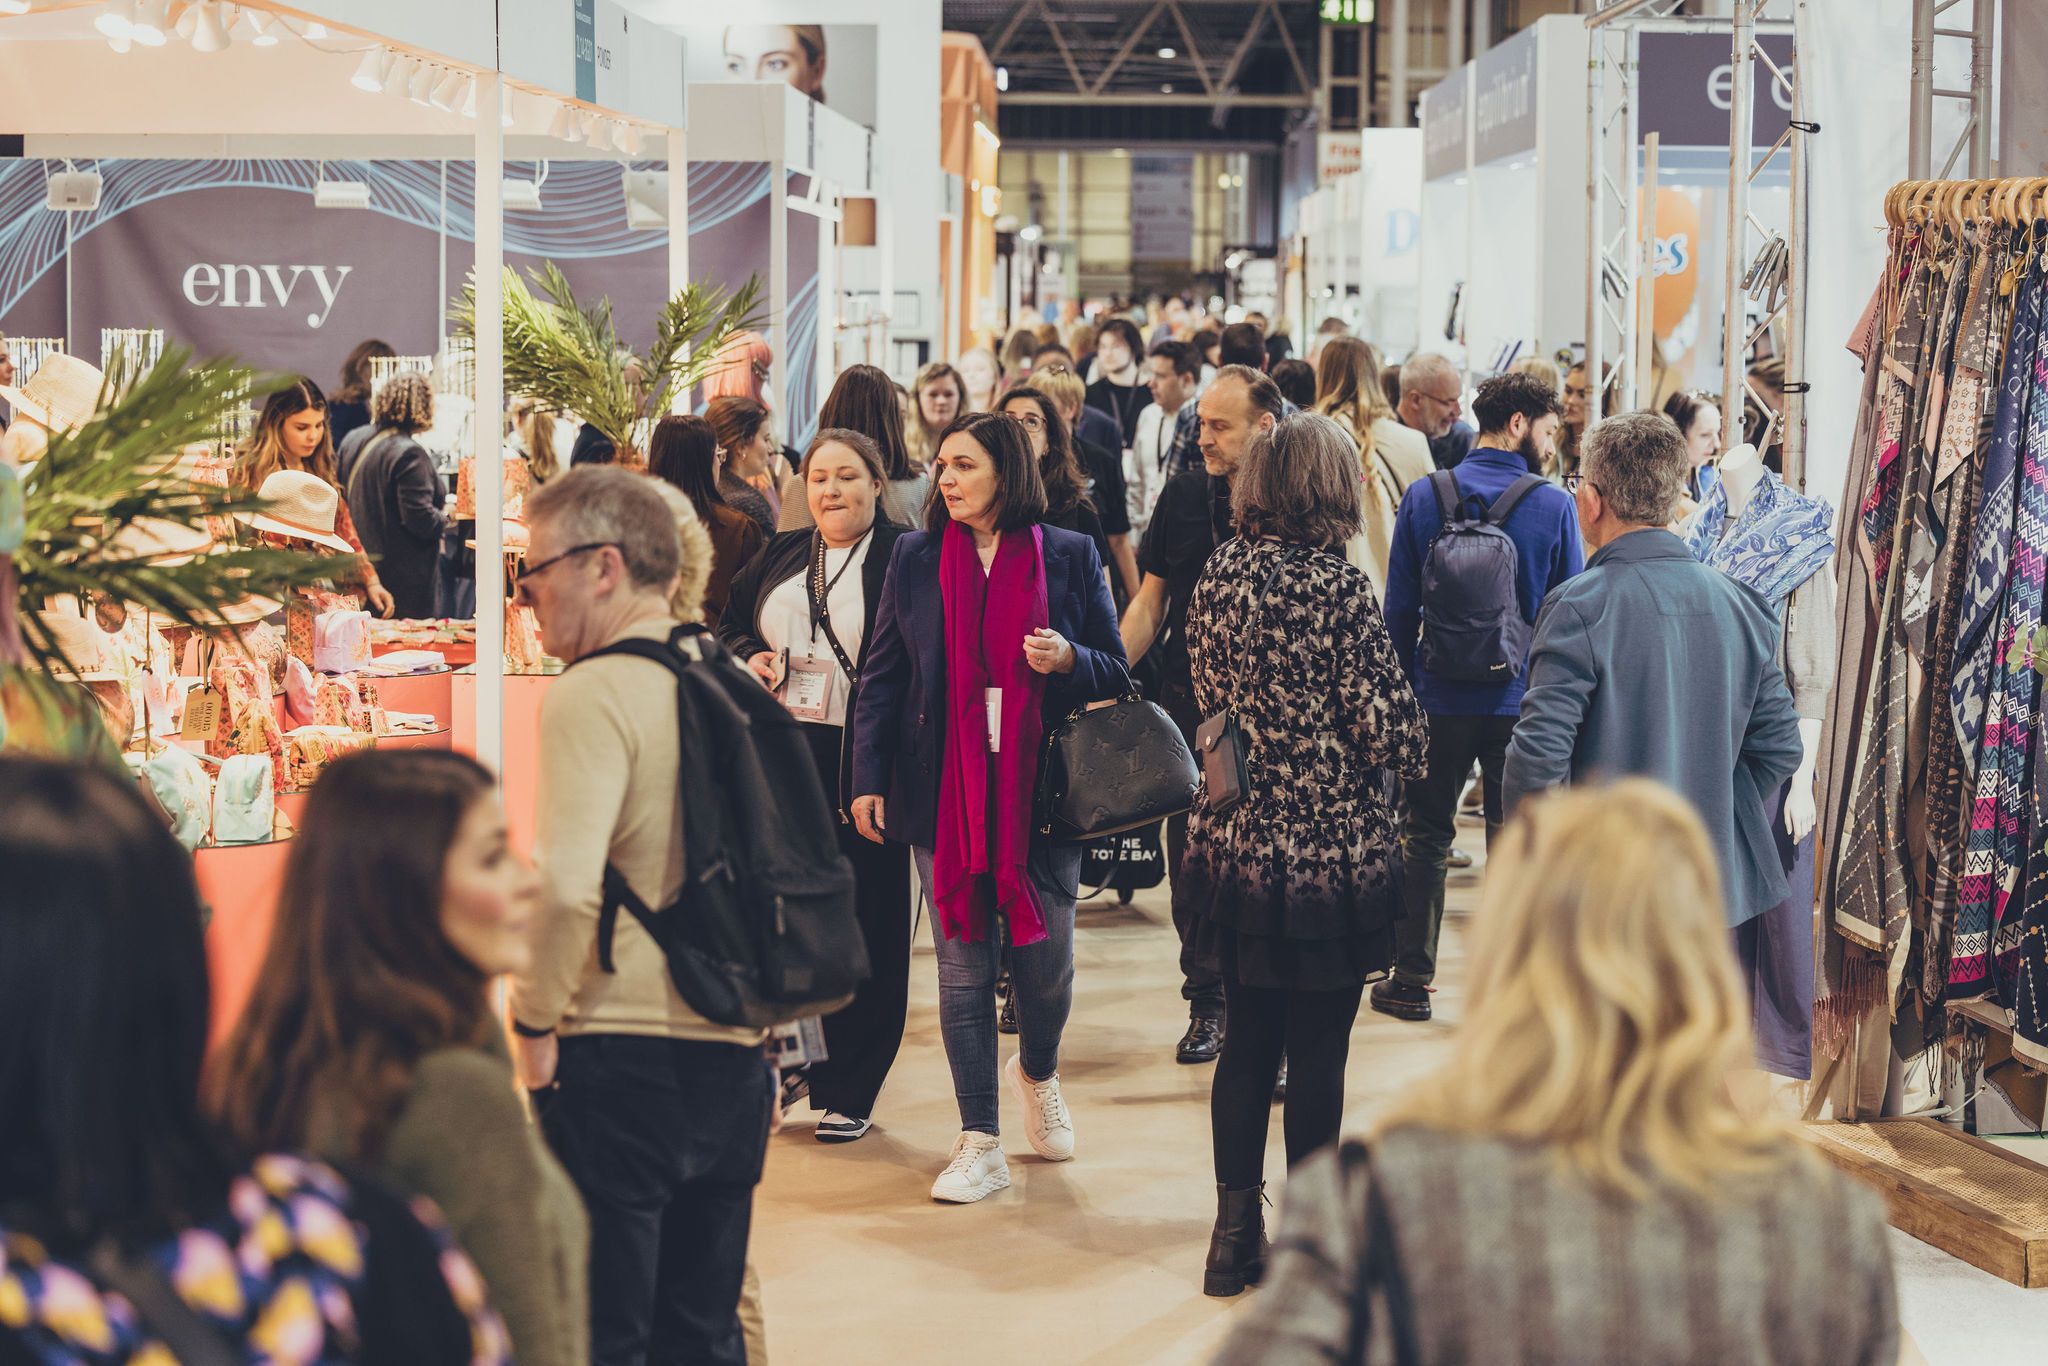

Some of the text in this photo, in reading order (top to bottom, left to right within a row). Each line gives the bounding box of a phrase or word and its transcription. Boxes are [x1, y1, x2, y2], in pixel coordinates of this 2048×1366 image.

[182, 263, 353, 328] envy
[202, 702, 213, 731] £10.00
[1091, 849, 1157, 861] TOTE BA
